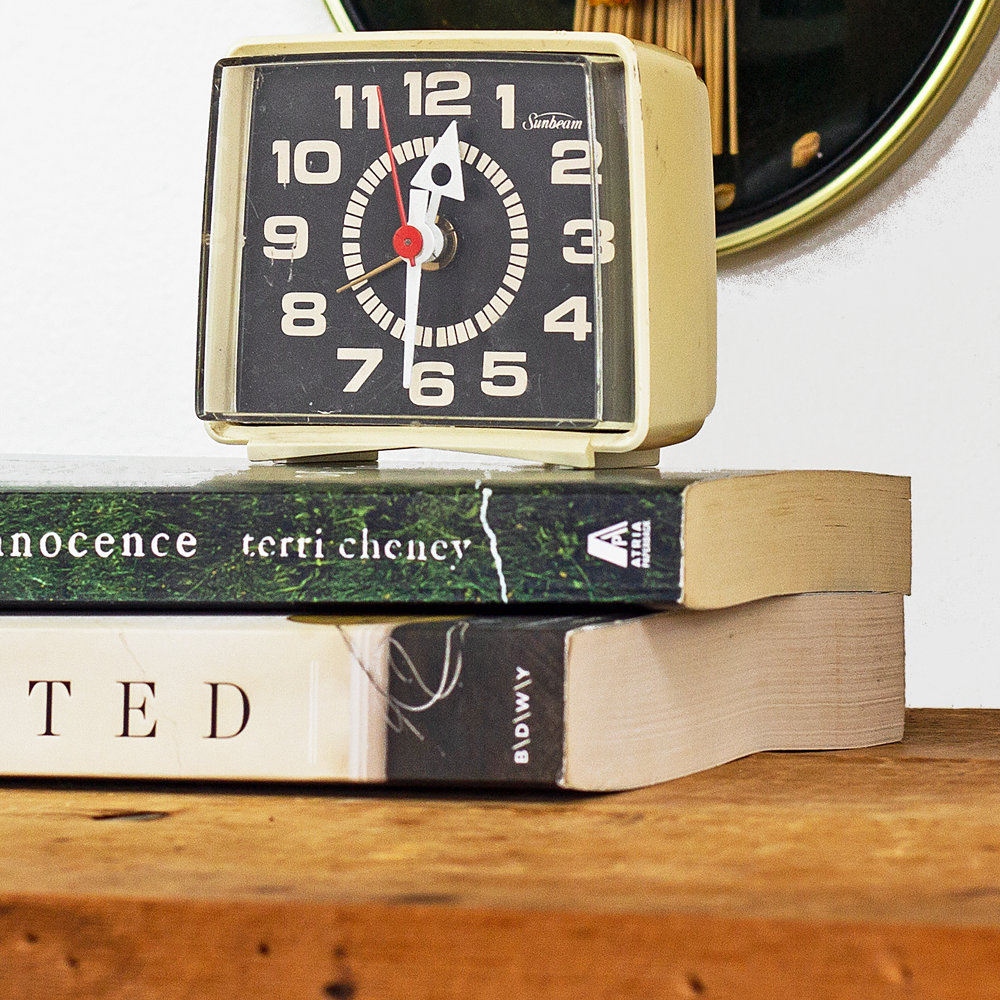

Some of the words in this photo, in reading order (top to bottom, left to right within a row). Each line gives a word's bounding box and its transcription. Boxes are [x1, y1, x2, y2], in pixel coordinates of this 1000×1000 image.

[335, 85, 381, 129] 11
[403, 71, 471, 116] 12
[495, 84, 515, 129] 1
[522, 112, 583, 131] Sunbeam
[272, 140, 342, 184] 10
[551, 139, 602, 184] 2
[263, 215, 309, 260] 9
[562, 218, 616, 264] 3
[281, 292, 327, 337] 8
[543, 296, 592, 341] 4
[336, 348, 383, 393] 7
[409, 361, 455, 407] 6
[480, 351, 528, 397] 5
[0, 530, 197, 558] nocence
[242, 527, 324, 559] terri
[338, 527, 472, 570] cheney
[630, 521, 643, 568] ATRIA
